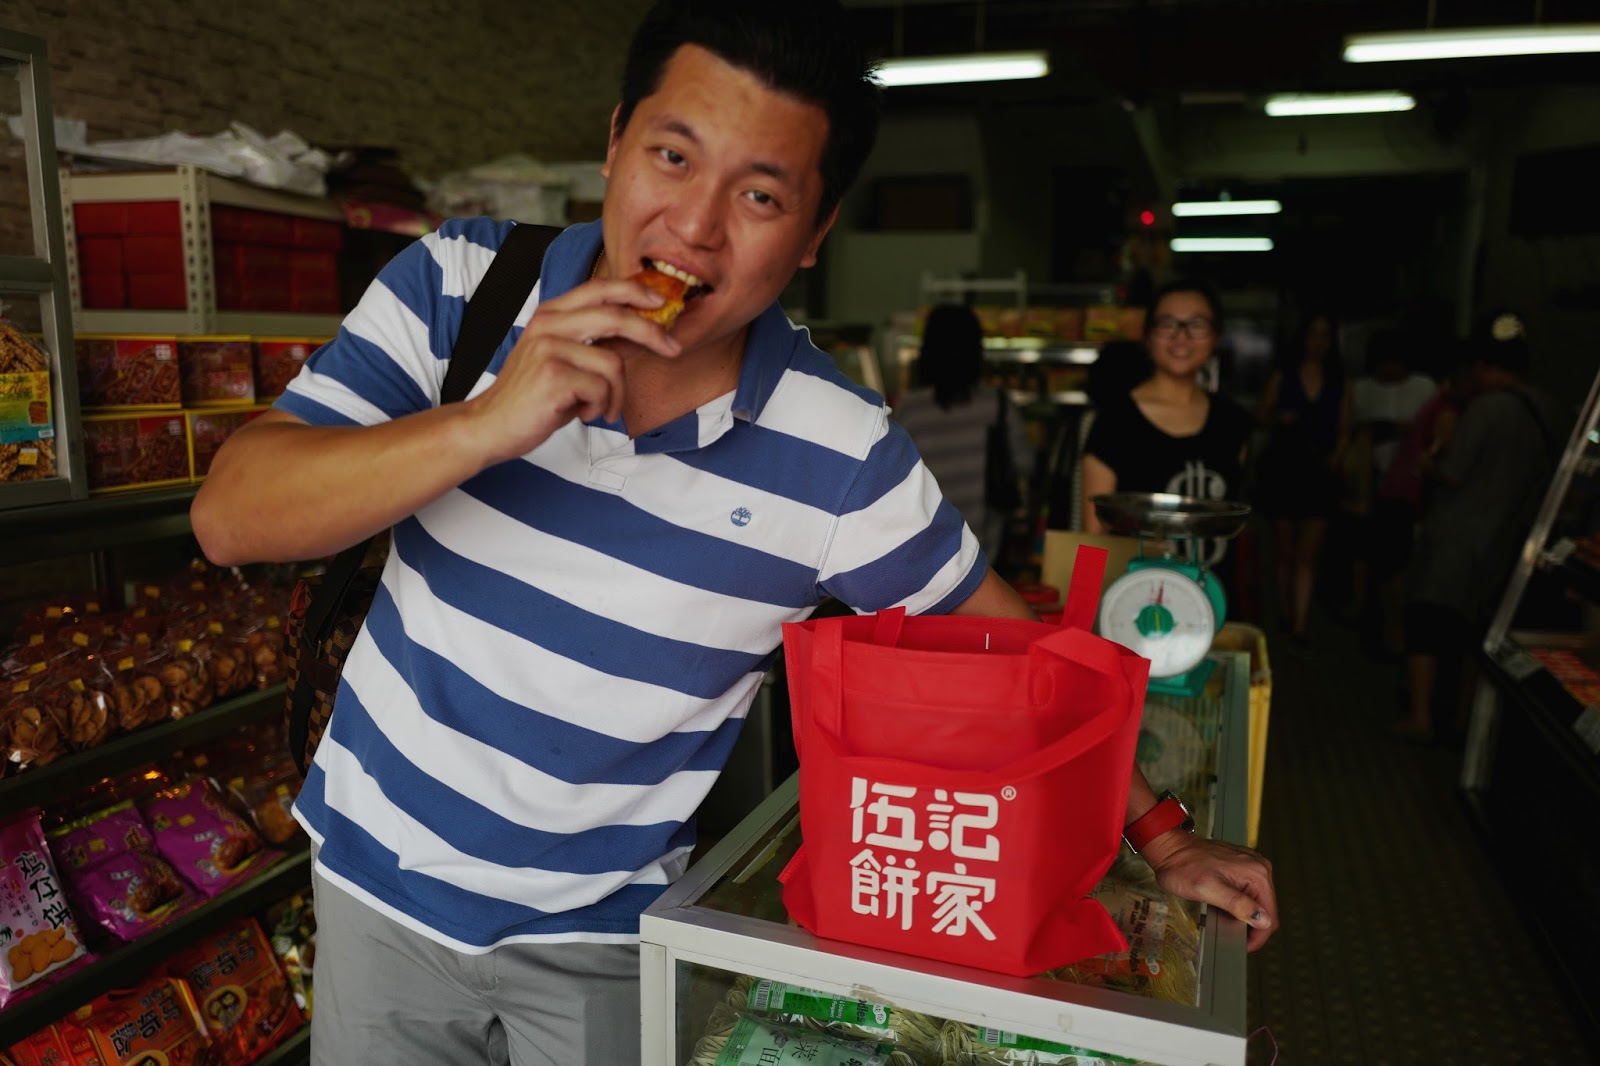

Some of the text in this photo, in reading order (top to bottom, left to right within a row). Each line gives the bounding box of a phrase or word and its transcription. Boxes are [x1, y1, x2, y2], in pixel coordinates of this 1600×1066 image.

[850, 776, 1000, 862] 伍記
[15, 852, 72, 929] 鸡仔饼
[849, 848, 997, 941] 餅家
